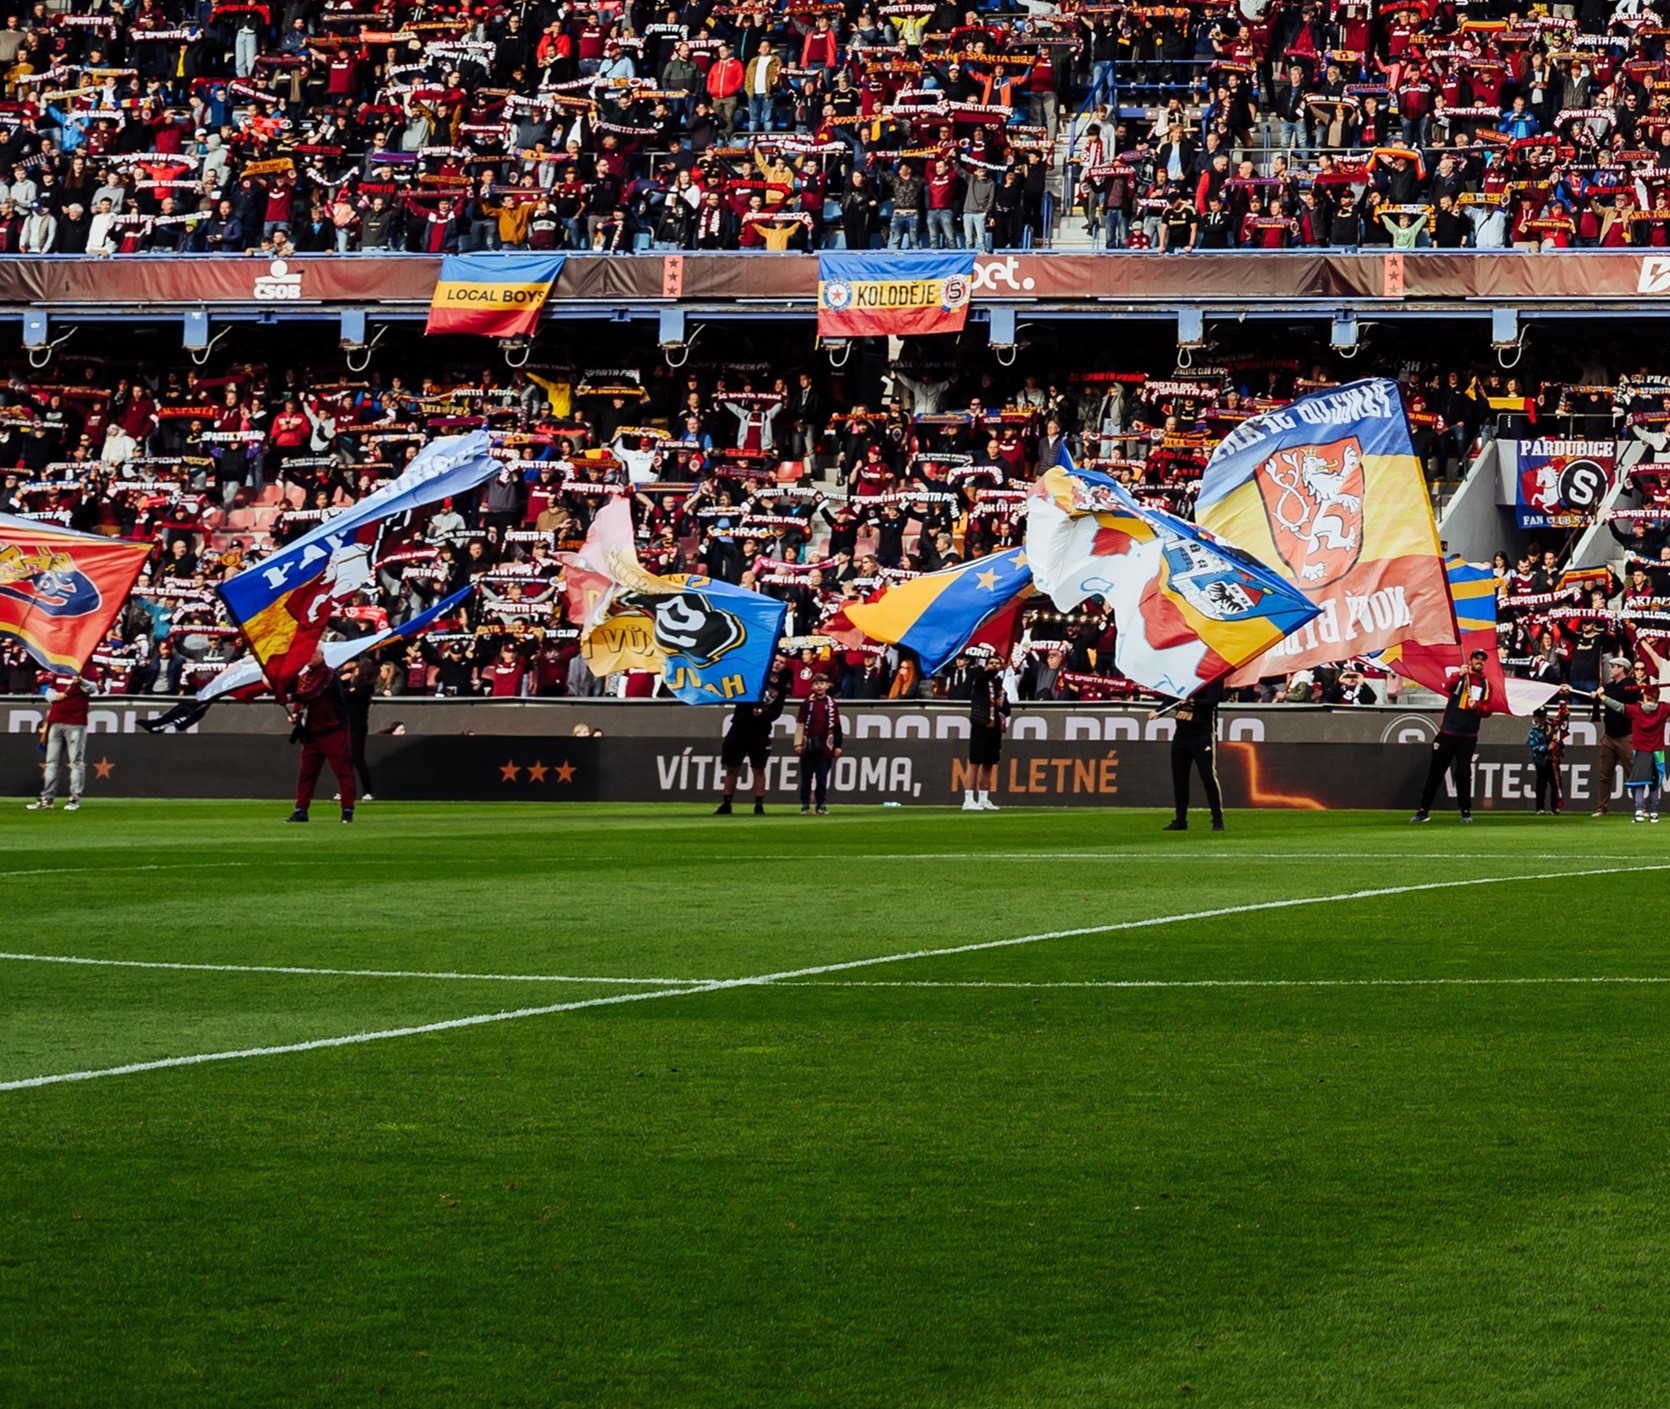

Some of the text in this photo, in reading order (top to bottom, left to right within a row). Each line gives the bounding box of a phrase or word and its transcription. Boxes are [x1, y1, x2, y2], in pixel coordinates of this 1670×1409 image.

[949, 101, 984, 111] SPARTA
[254, 283, 301, 300] ČSOB
[447, 288, 498, 302] LOCAL
[857, 280, 936, 307] KOLODĚJE
[1520, 440, 1614, 458] PARDUBICE
[1522, 515, 1544, 526] FAN
[1617, 509, 1658, 518] SPARTA
[1008, 750, 1119, 793] LETNÉ
